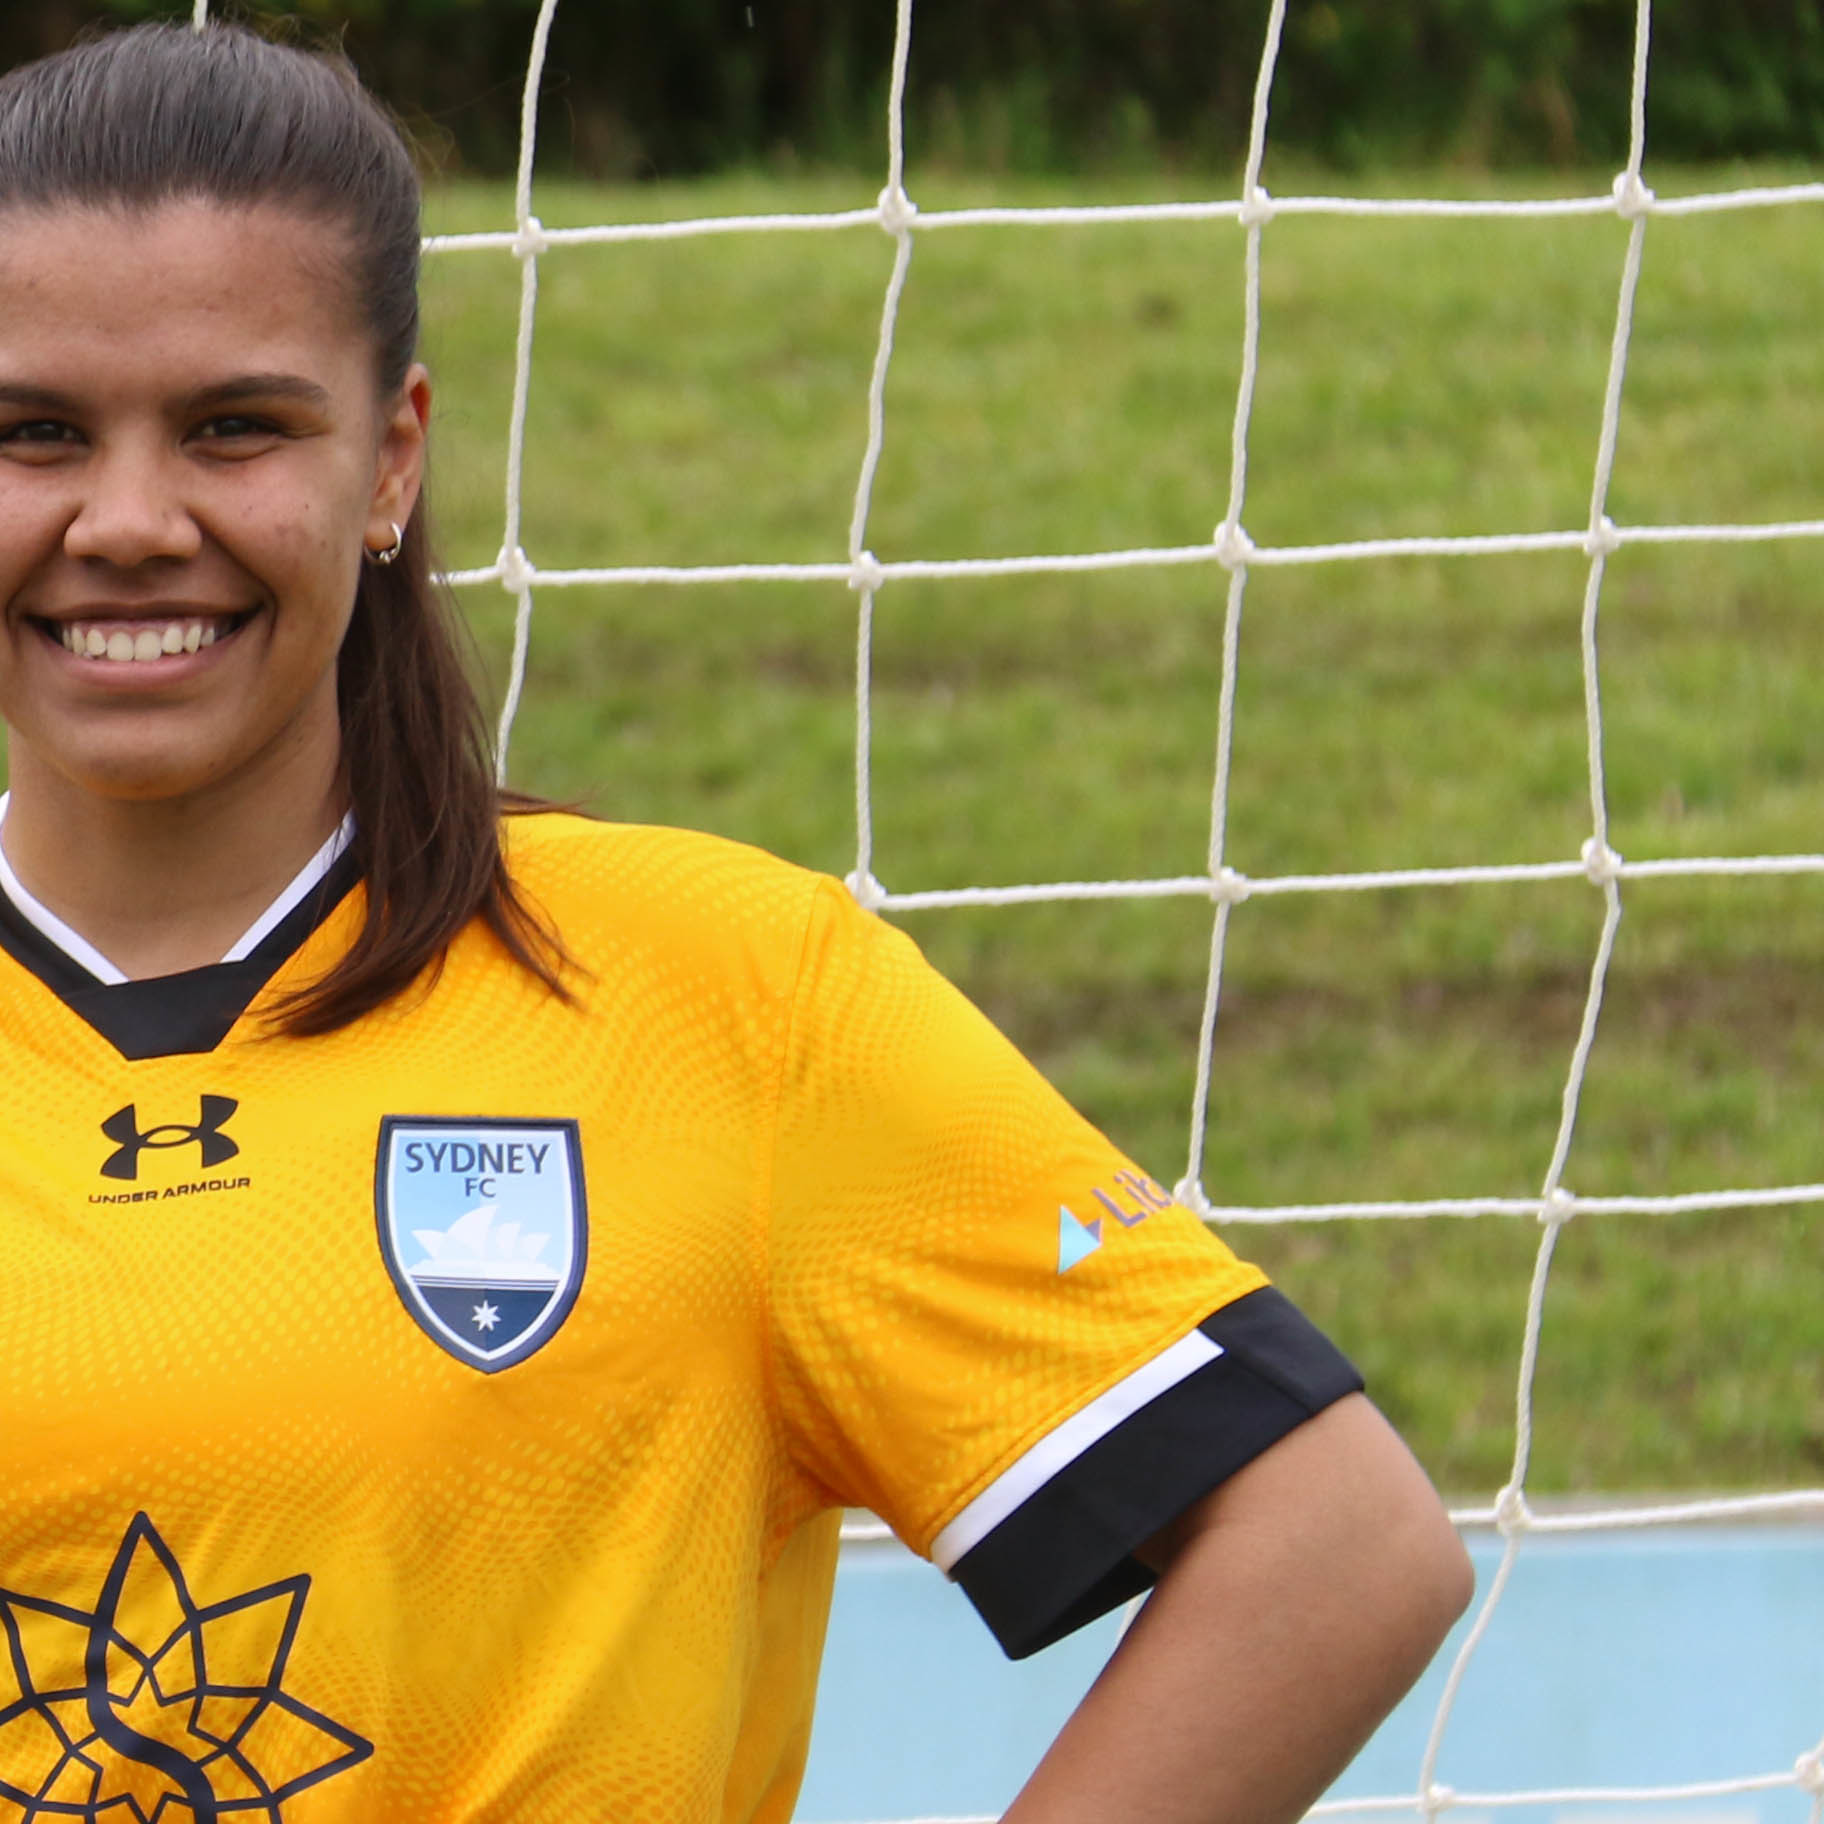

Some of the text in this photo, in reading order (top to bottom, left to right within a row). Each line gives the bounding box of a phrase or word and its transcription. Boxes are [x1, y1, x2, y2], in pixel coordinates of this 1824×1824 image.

[405, 1142, 551, 1174] SYDNEY
[88, 1177, 251, 1204] UNDER ARMOUR
[464, 1178, 496, 1198] FC
